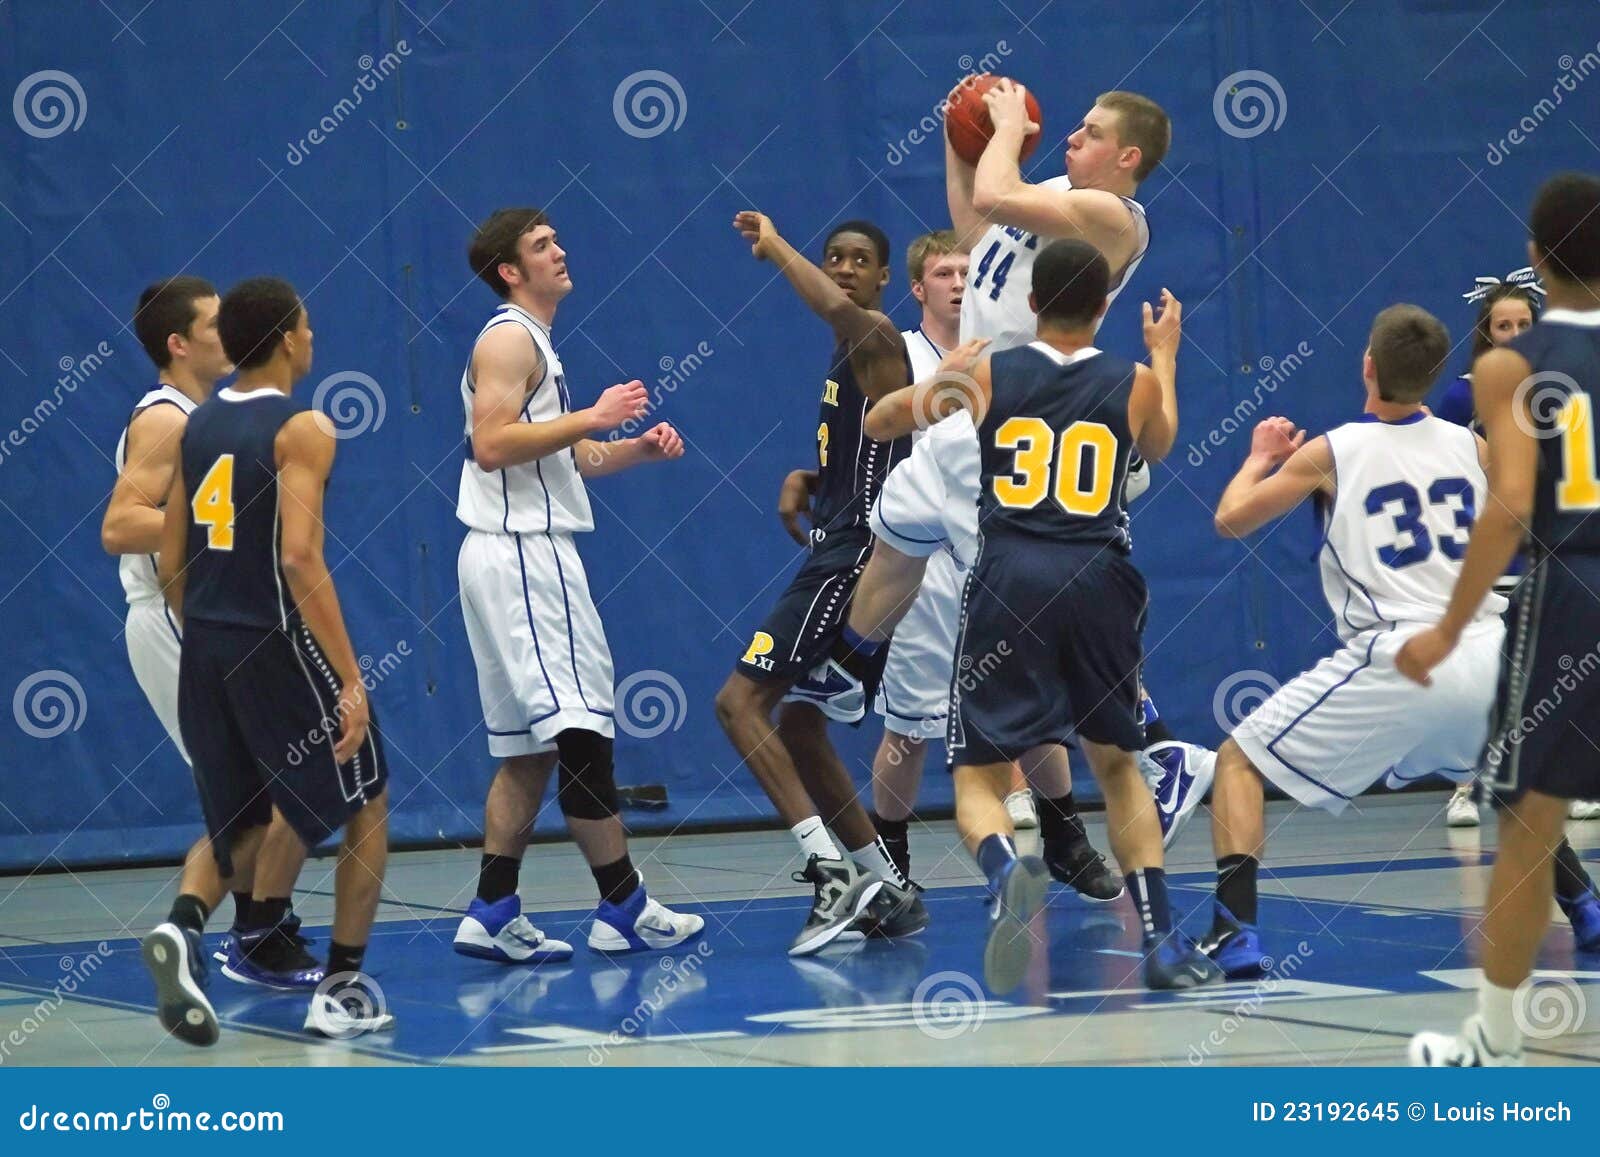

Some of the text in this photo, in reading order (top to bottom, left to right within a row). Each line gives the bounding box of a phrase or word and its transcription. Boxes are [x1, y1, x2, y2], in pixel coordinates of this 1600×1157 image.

[974, 240, 1016, 301] 44
[192, 453, 234, 551] 4
[994, 417, 1118, 517] 30
[1363, 476, 1476, 571] 33
[741, 631, 775, 671] P XI
